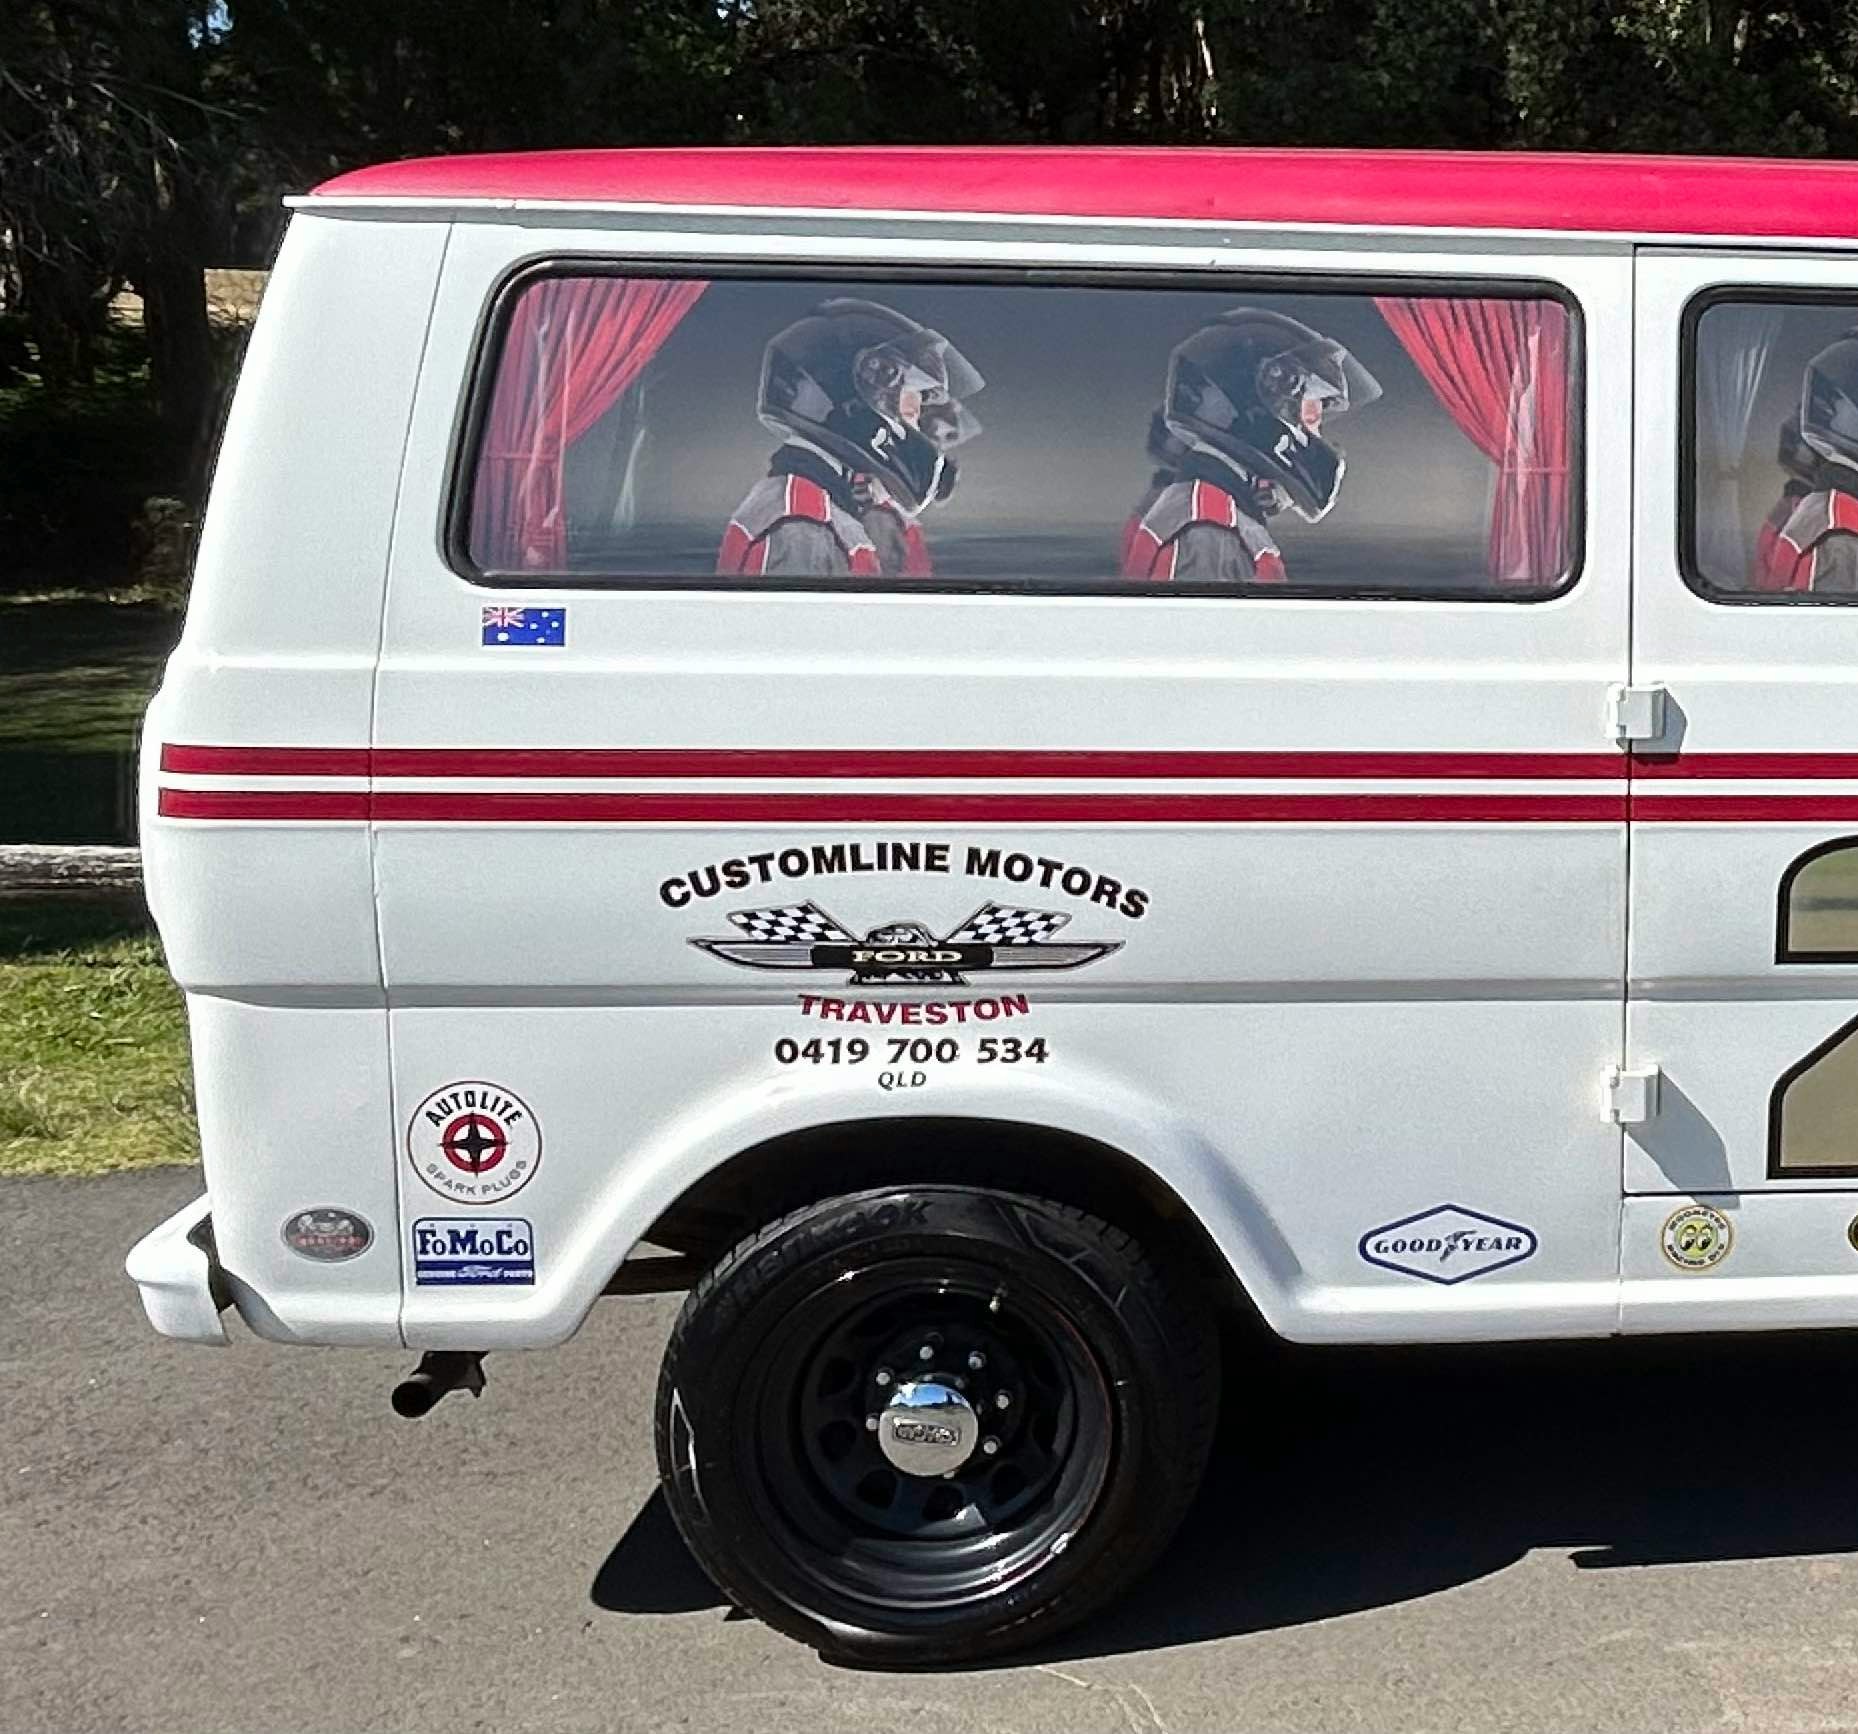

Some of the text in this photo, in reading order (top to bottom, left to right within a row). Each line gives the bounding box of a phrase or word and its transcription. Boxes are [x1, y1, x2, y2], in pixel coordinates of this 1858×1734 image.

[659, 841, 1151, 920] CUSTOMLINE MOTORS
[852, 949, 963, 963] FORD
[796, 994, 1029, 1026] TRAVESTON
[774, 1037, 1050, 1065] 0419 700 534
[877, 1070, 928, 1090] QLD
[425, 1090, 523, 1128] AUTOLITE
[417, 1228, 530, 1256] FoMoCo
[1373, 1231, 1523, 1263] GOODYEAR
